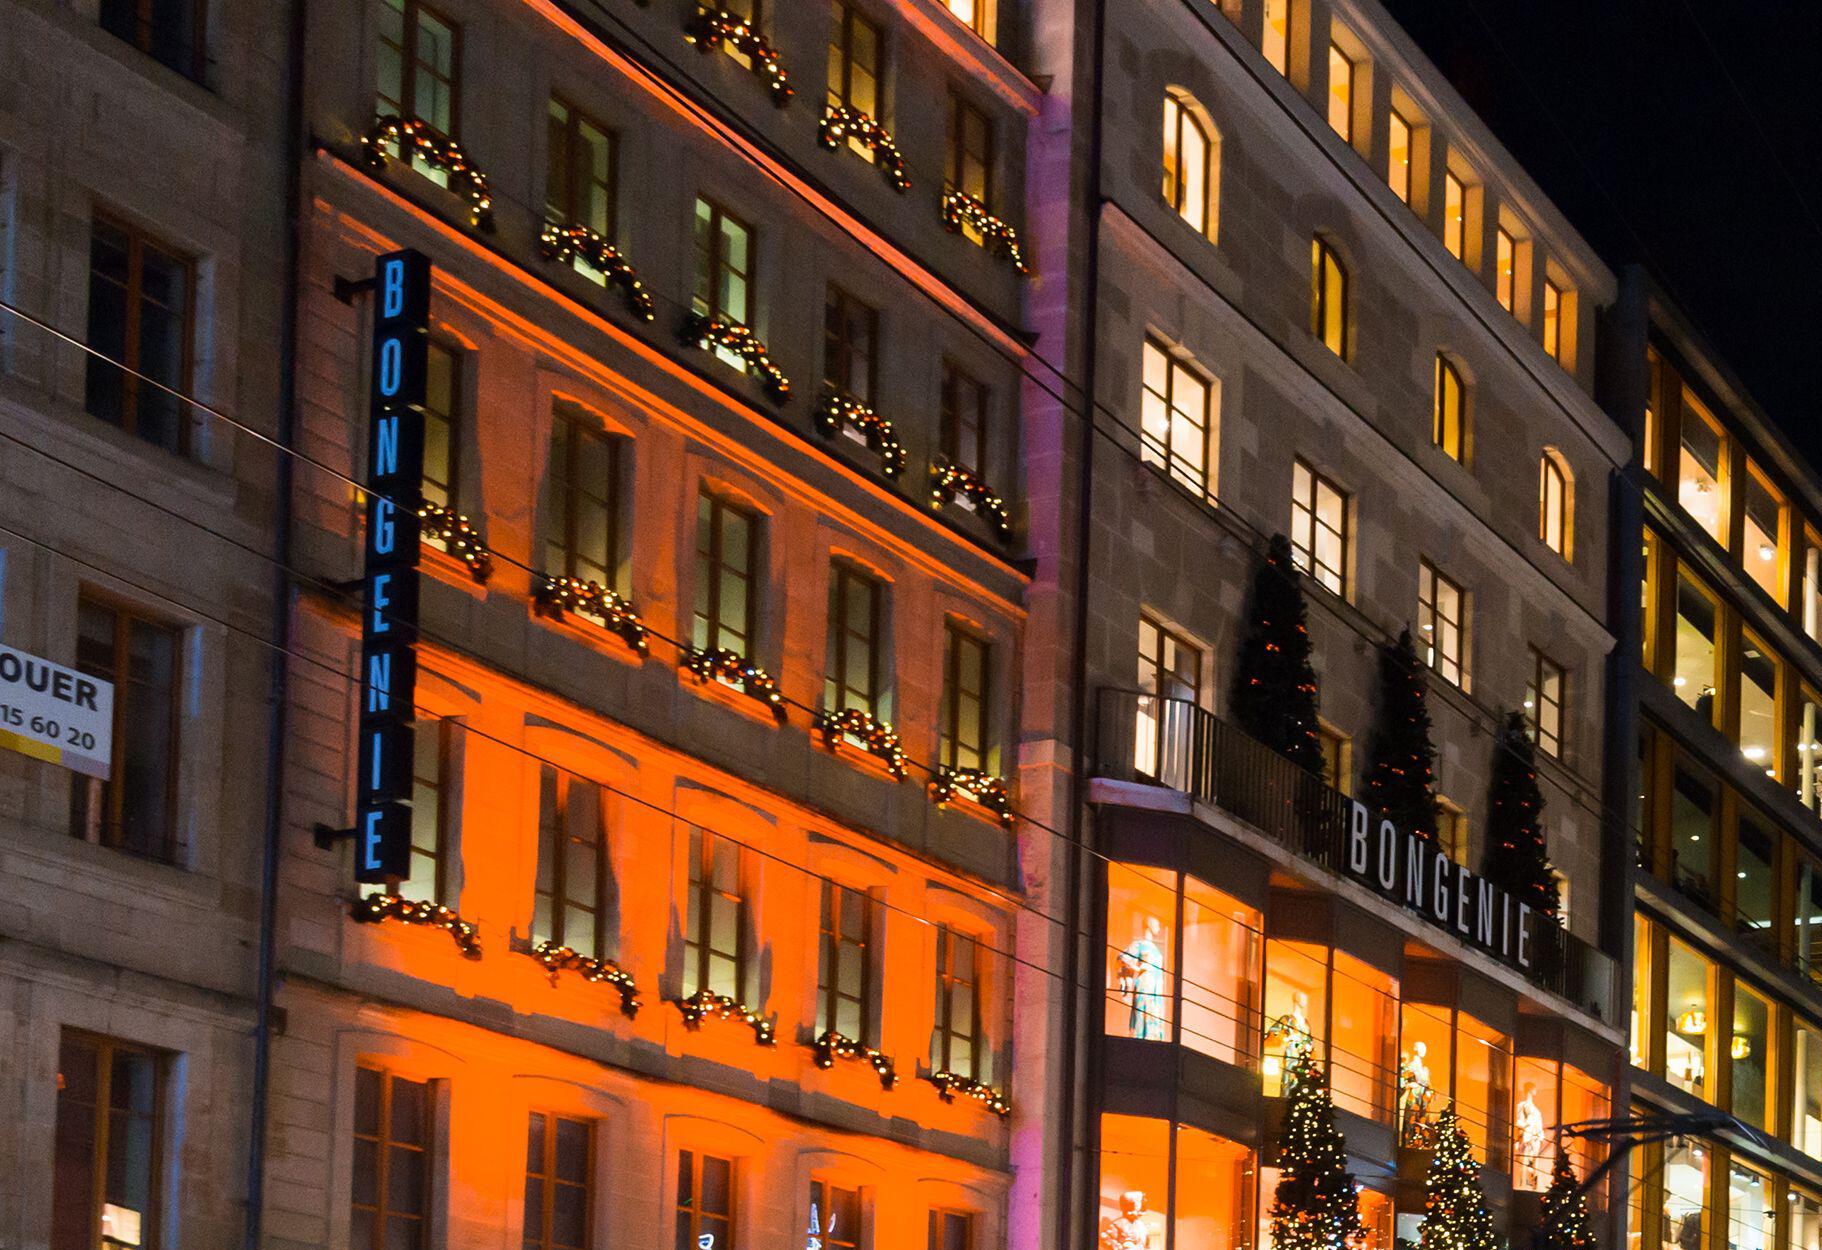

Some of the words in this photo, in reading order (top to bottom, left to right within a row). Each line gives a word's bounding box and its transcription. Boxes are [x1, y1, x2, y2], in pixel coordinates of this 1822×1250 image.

[363, 258, 404, 871] BONGENIE
[30, 716, 60, 739] 60
[66, 726, 96, 751] 20
[1350, 799, 1531, 968] BONGENIE
